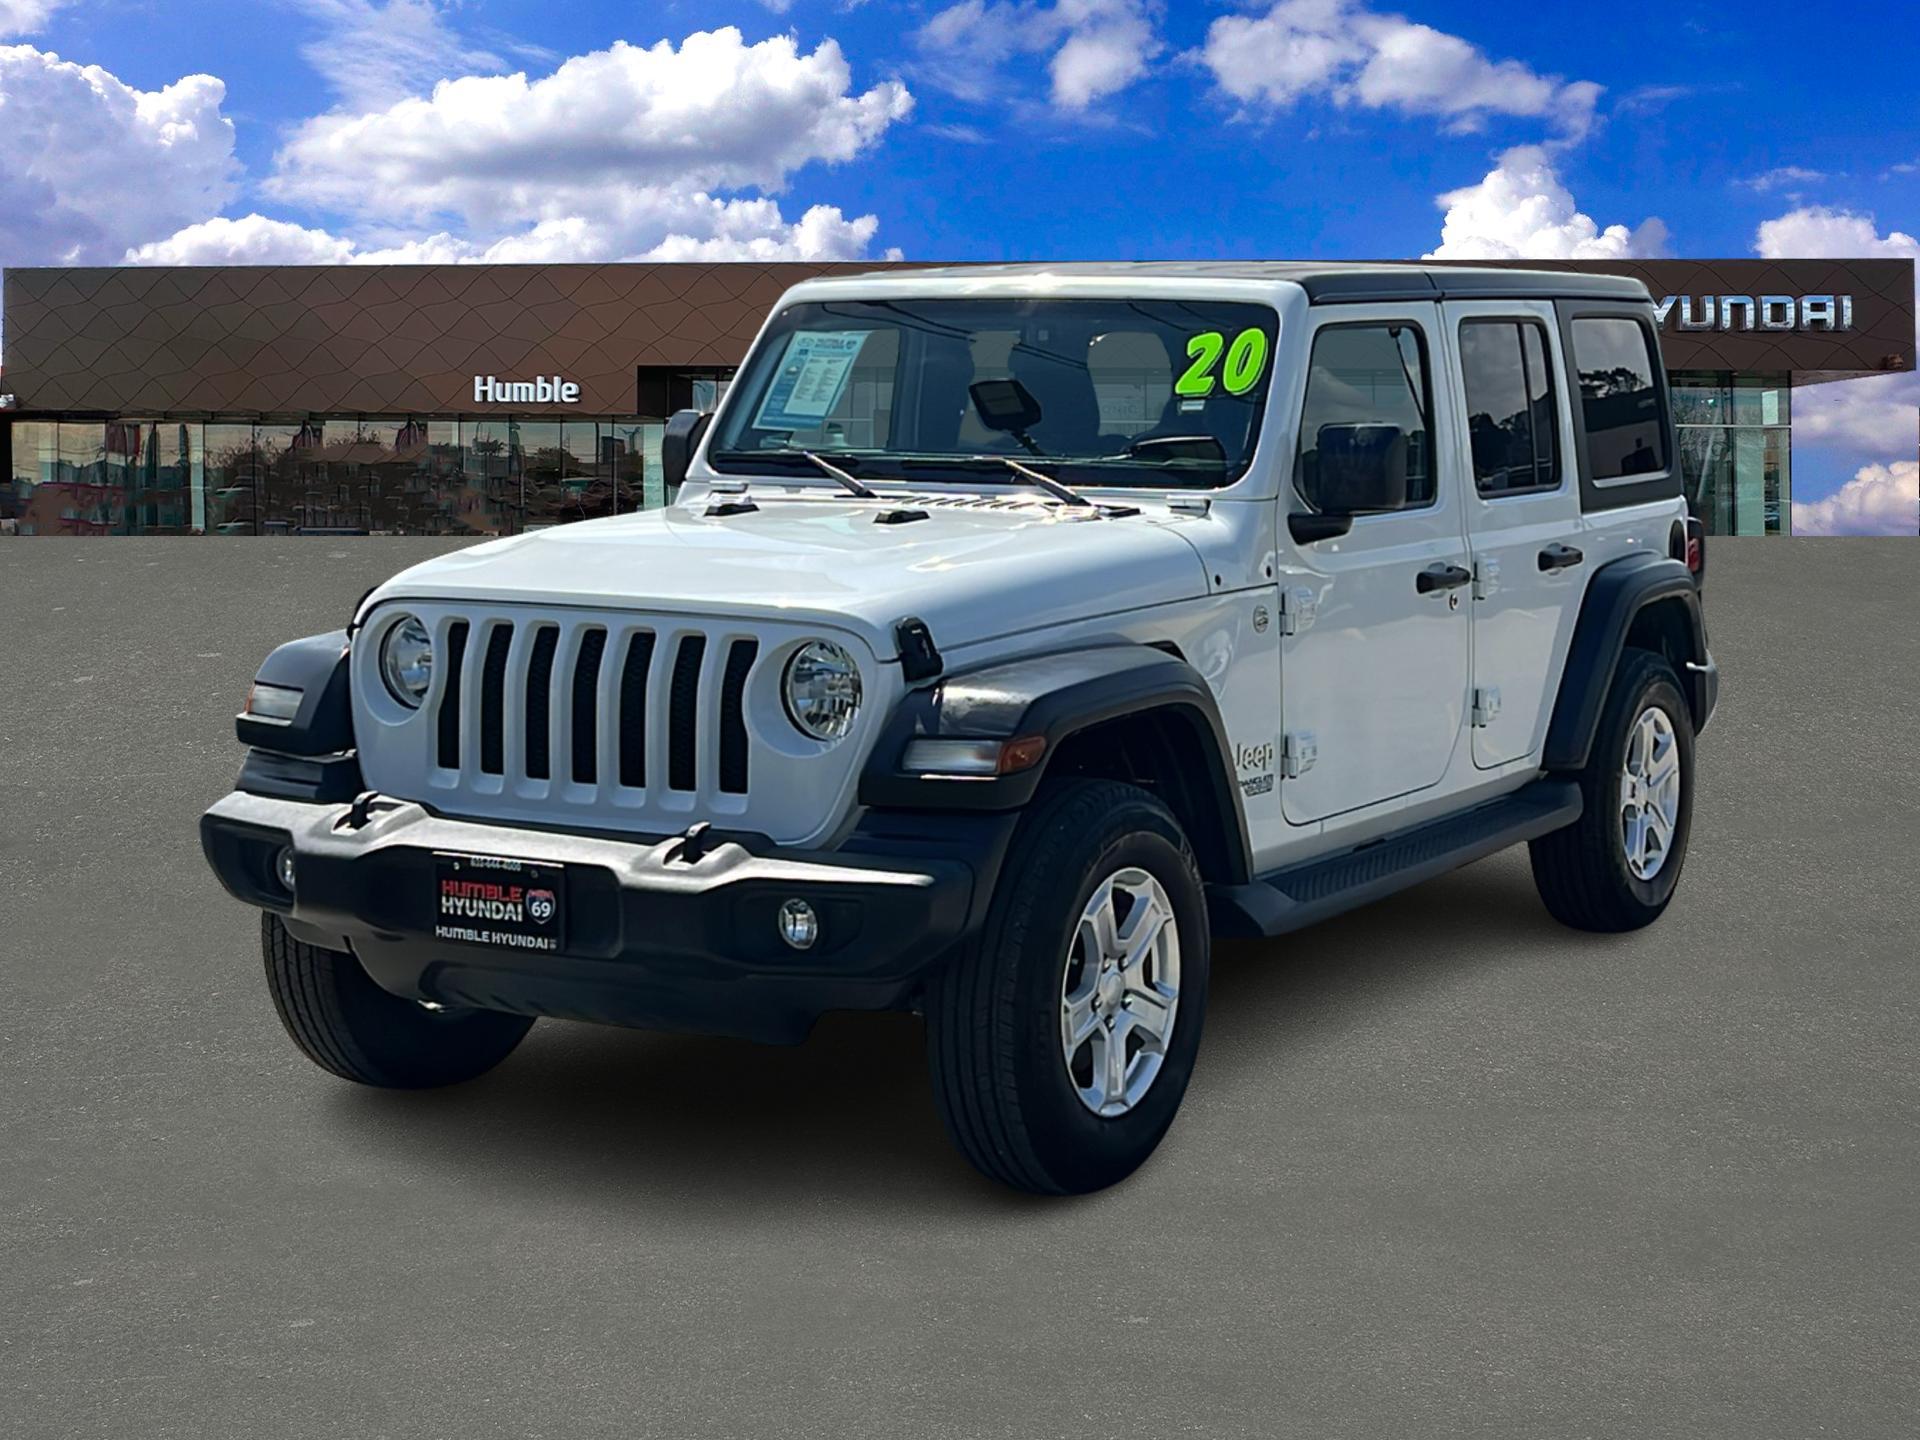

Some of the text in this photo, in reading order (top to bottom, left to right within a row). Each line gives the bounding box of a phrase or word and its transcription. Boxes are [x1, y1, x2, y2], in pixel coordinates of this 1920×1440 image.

[1652, 295, 1851, 331] YUNDAI
[1175, 328, 1268, 397] 20
[474, 375, 580, 403] Humble
[1237, 742, 1272, 771] Jeep
[441, 880, 523, 902] HUMBLE
[441, 896, 523, 922] HYUNDAI
[531, 901, 551, 917] 69
[435, 925, 490, 943] HUMBLE
[491, 931, 548, 949] HYUNDAI
